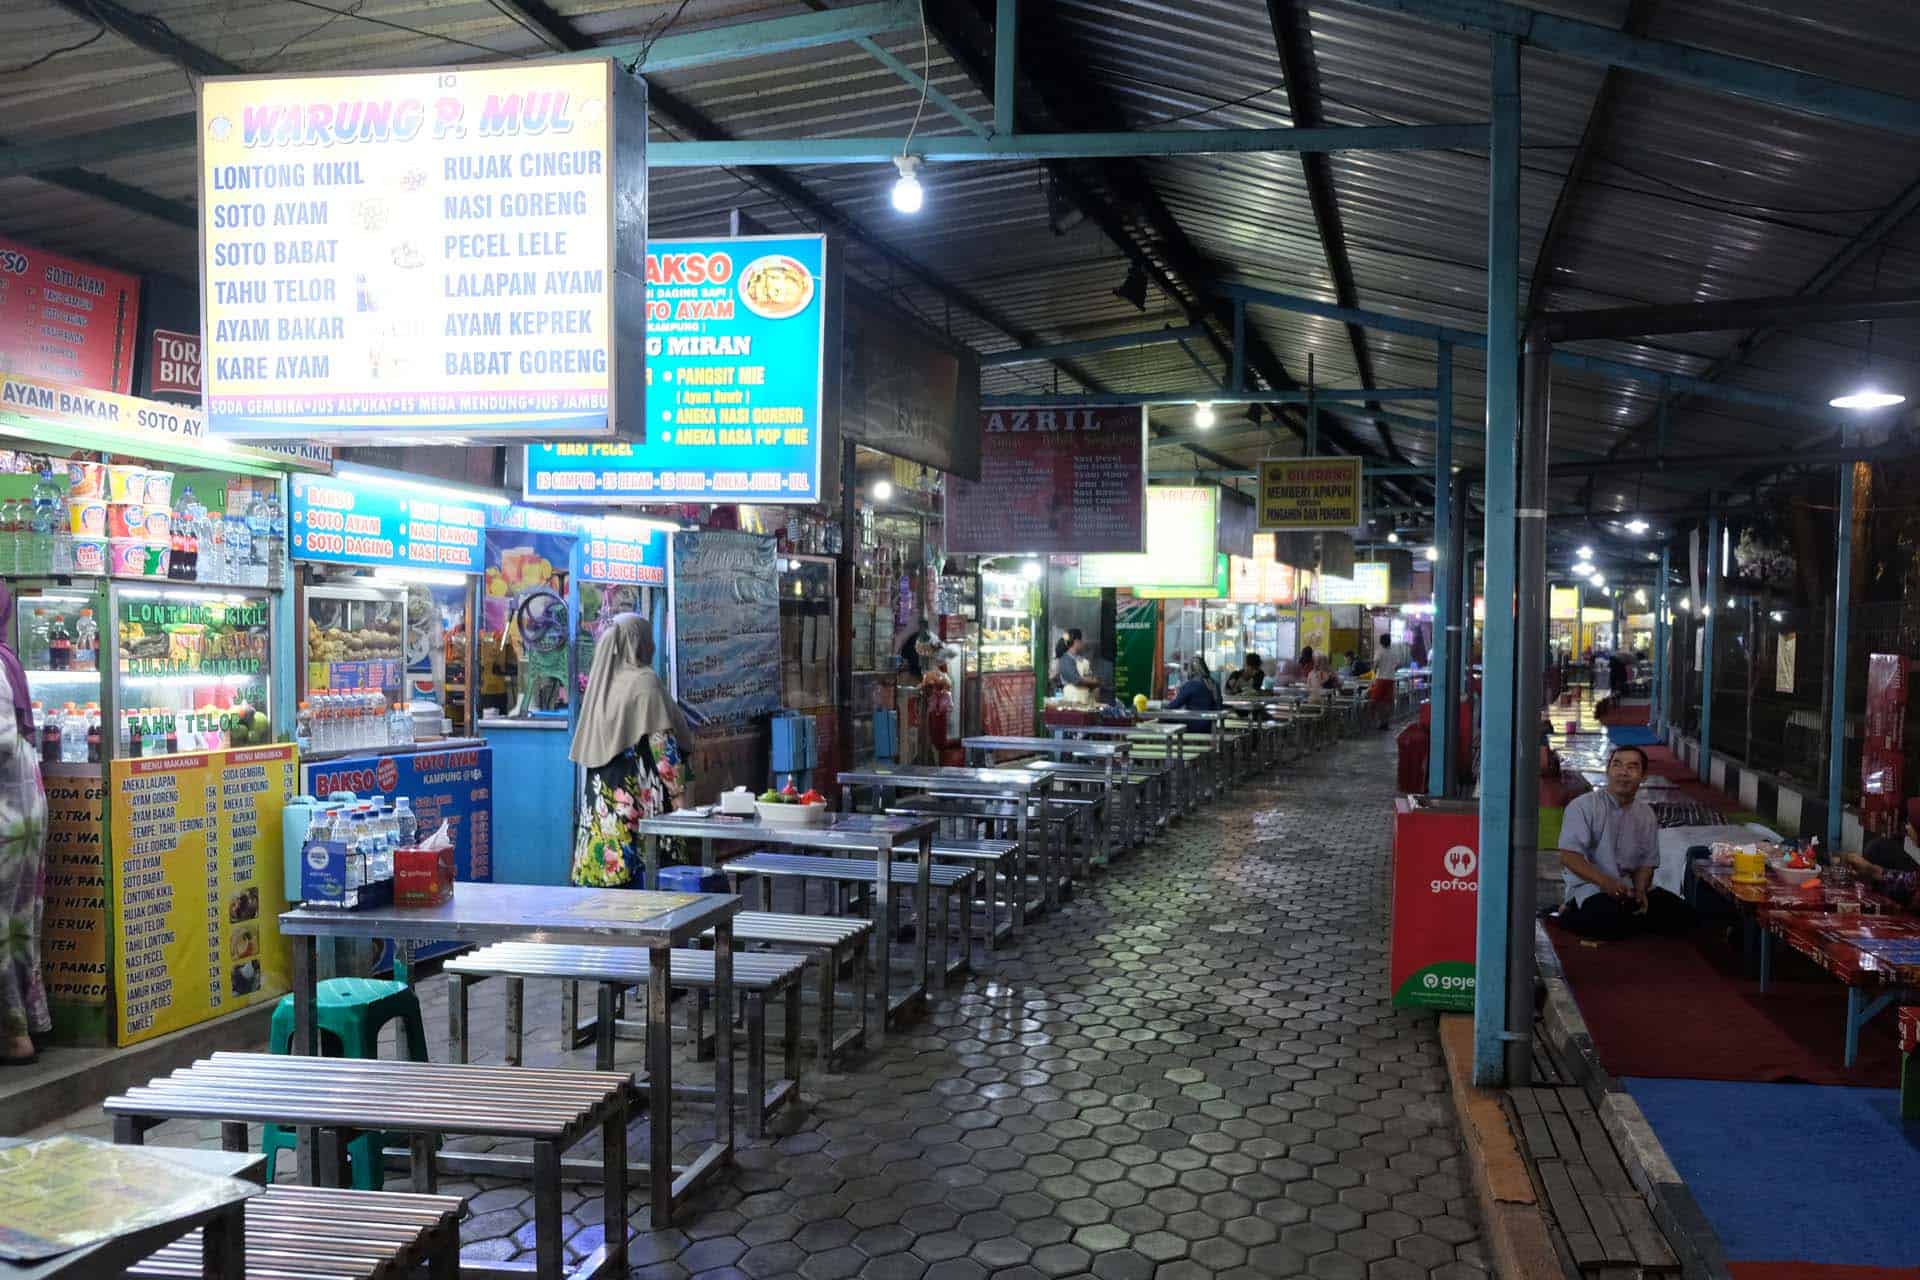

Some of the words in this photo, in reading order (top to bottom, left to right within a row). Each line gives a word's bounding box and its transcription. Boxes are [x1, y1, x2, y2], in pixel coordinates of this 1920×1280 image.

[243, 98, 425, 147] WARUNG
[479, 91, 575, 136] MUL
[214, 164, 305, 189] LONTONG
[313, 161, 365, 186] KIKIL
[444, 155, 512, 180] RUJAK
[520, 151, 601, 177] CINGUR
[214, 204, 265, 228] SOTO
[273, 201, 328, 226] AYAM
[444, 196, 491, 219] NASI
[500, 191, 586, 217] GORENG
[215, 243, 265, 266] SOTO
[275, 240, 338, 264] BABAT
[445, 234, 510, 258] PECEL
[519, 232, 566, 256] LELE
[0, 252, 28, 275] SO
[646, 253, 732, 284] AKSO
[45, 267, 73, 287] SOTO
[76, 274, 105, 296] AYAM
[445, 273, 537, 297] LALAPAN
[545, 270, 602, 295] AYAM
[216, 281, 266, 304] TAHU
[275, 279, 336, 302] TELOR
[646, 301, 670, 319] TO
[676, 301, 734, 319] AYAM
[216, 319, 269, 342] AYAM
[278, 317, 345, 340] BAKAR
[445, 313, 500, 336] AYAM
[510, 310, 591, 334] KEPREK
[668, 336, 752, 356] MIRAN
[217, 357, 267, 380] KARE
[276, 355, 329, 378] AYAM
[445, 352, 511, 375] BABAT
[520, 349, 606, 373] GORENG
[3, 384, 54, 409] AYAM
[61, 395, 119, 421] BAKAR
[138, 411, 177, 432] SOTO
[183, 419, 204, 437] AY
[211, 401, 243, 414] SODA
[563, 394, 607, 409] JAMBU
[677, 408, 716, 424] ANEKA
[720, 408, 749, 424] NASI
[753, 407, 803, 424] GORENG
[985, 411, 1100, 432] AZRIL
[676, 428, 716, 445] ANEKA
[756, 428, 781, 445] POP
[784, 428, 808, 445] MIE
[301, 444, 331, 462] KIKIL
[308, 487, 354, 510] BAKSO
[308, 511, 342, 529] SOTO
[344, 515, 380, 534] AYAM
[409, 523, 436, 541] NASI
[439, 526, 477, 545] RAWON
[308, 534, 342, 552] SOTO
[345, 538, 392, 557] DAGING
[409, 545, 436, 560] NASI
[438, 547, 471, 564] PECEL
[592, 541, 605, 557] ES
[592, 561, 605, 577] ES
[608, 563, 636, 579] JUICE
[638, 564, 663, 582] BUAH
[128, 605, 213, 624] LONTONG
[225, 607, 266, 624] KIKIL
[128, 659, 188, 676] RUJAK
[128, 714, 176, 735] TAHU
[185, 713, 240, 733] TELOR
[141, 761, 162, 770] MENU
[164, 759, 199, 768] MAKANAN
[235, 753, 253, 761] MENU
[414, 754, 445, 771] SOTO
[448, 751, 479, 767] AYAM
[240, 767, 265, 778] GEMBIRA
[424, 772, 462, 784] KAMPUNG
[122, 779, 145, 791] ANEKA
[146, 776, 175, 789] LALAPAN
[224, 784, 240, 794] MEGA
[316, 769, 374, 797] BAKSO
[133, 794, 151, 805] AYAM
[152, 791, 178, 802] GORENG
[224, 799, 243, 810] ANEKA
[48, 809, 91, 822] EXTRA
[133, 810, 151, 822] AYAM
[153, 807, 175, 819] BAKAR
[133, 842, 149, 854] LELE
[151, 838, 176, 850] GORENG
[123, 859, 140, 872] SOTO
[143, 856, 160, 869] AYAM
[124, 875, 141, 888] SOTO
[143, 871, 164, 884] BABAT
[234, 870, 252, 881] TOMAT
[124, 888, 154, 904] LONTONG
[157, 886, 173, 897] KIKIL
[1431, 879, 1478, 893] gofoo
[124, 906, 145, 920] RUJAK
[147, 901, 172, 915] CINGUR
[49, 920, 96, 931] JERUK
[125, 922, 143, 936] TAHU
[144, 919, 164, 931] TELOR
[50, 940, 76, 951] TEH
[126, 939, 143, 952] TAHU
[145, 932, 175, 948] LONTONG
[60, 962, 105, 974] PANAS
[126, 956, 141, 968] NASI
[144, 951, 163, 964] PECEL
[127, 970, 144, 984] TAHU
[146, 965, 167, 979] KRISPI
[1441, 975, 1475, 990] goje
[128, 985, 149, 1000] JAMUR
[151, 979, 172, 993] KRISPI
[128, 1003, 149, 1017] CEKER
[151, 995, 171, 1009] PEDES
